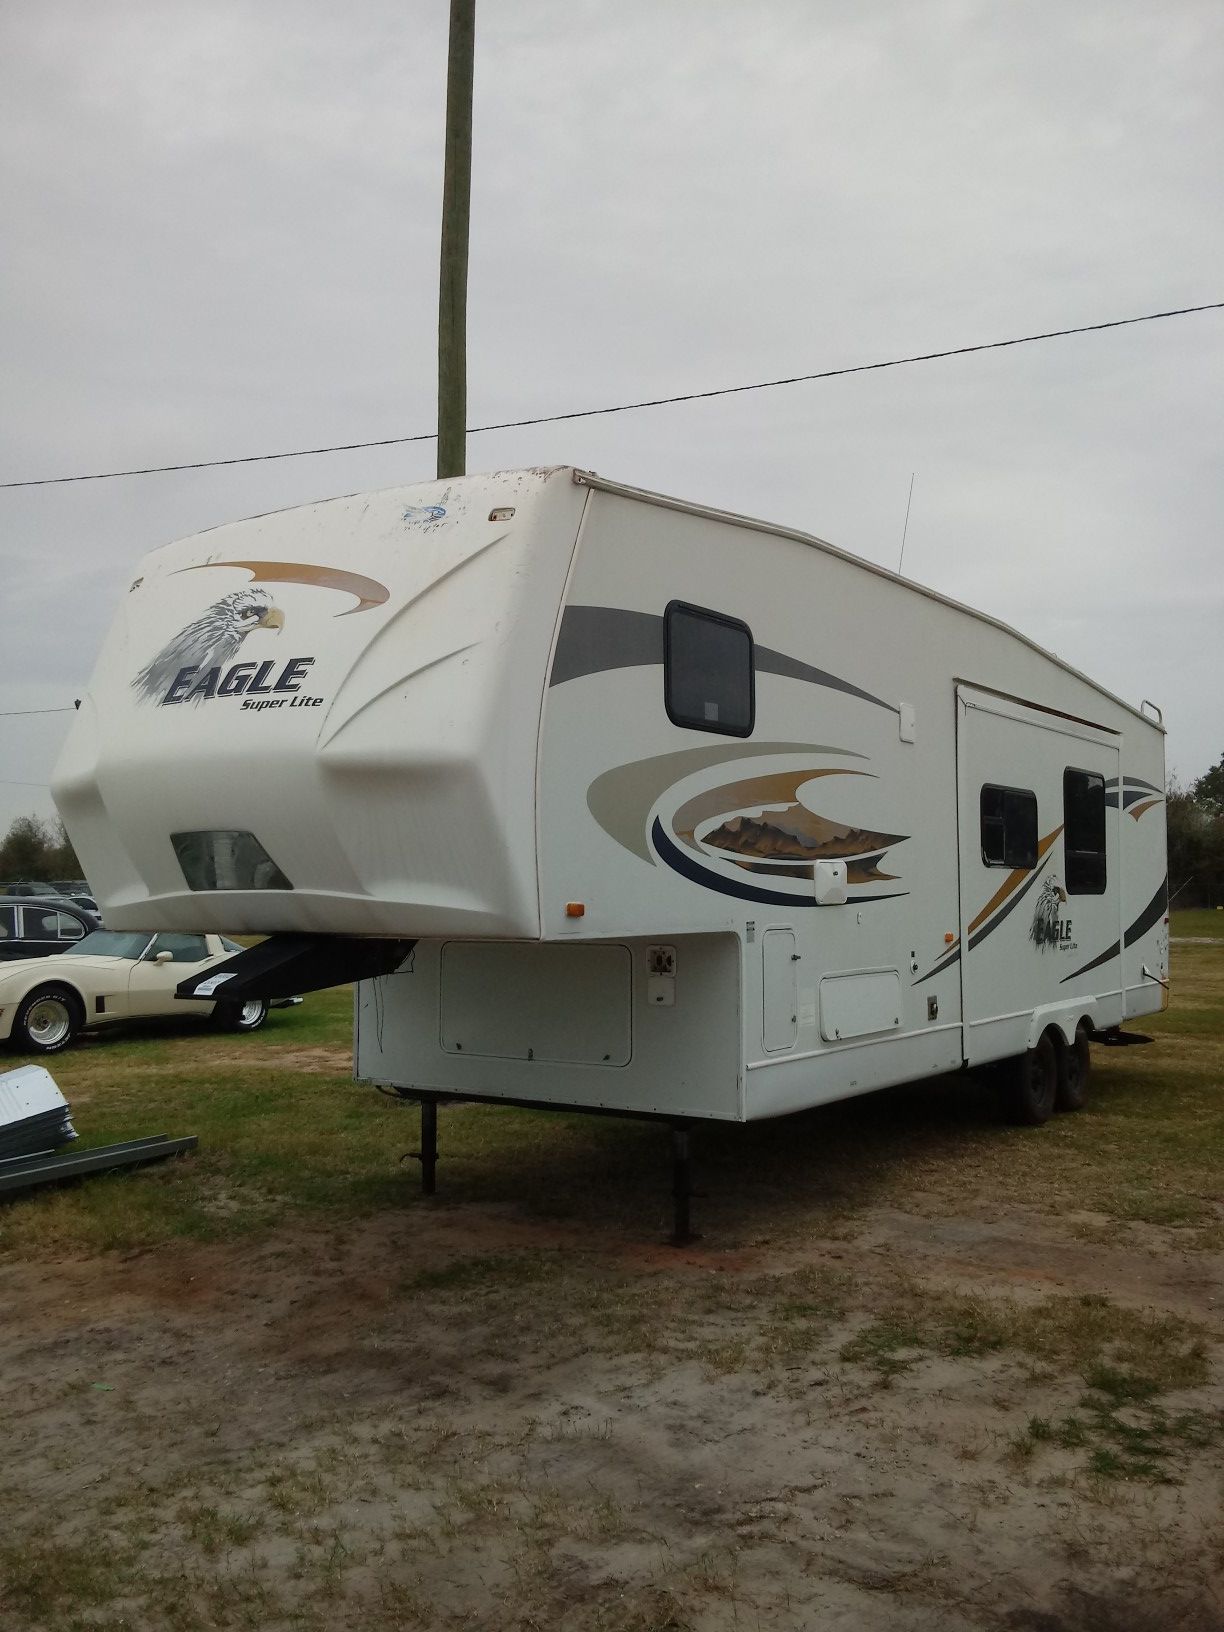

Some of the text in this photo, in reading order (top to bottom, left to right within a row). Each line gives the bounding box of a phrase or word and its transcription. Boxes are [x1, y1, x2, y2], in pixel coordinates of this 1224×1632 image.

[162, 657, 315, 706] EAGLE
[240, 695, 324, 711] Super Lite
[1035, 919, 1072, 944] EAGLE
